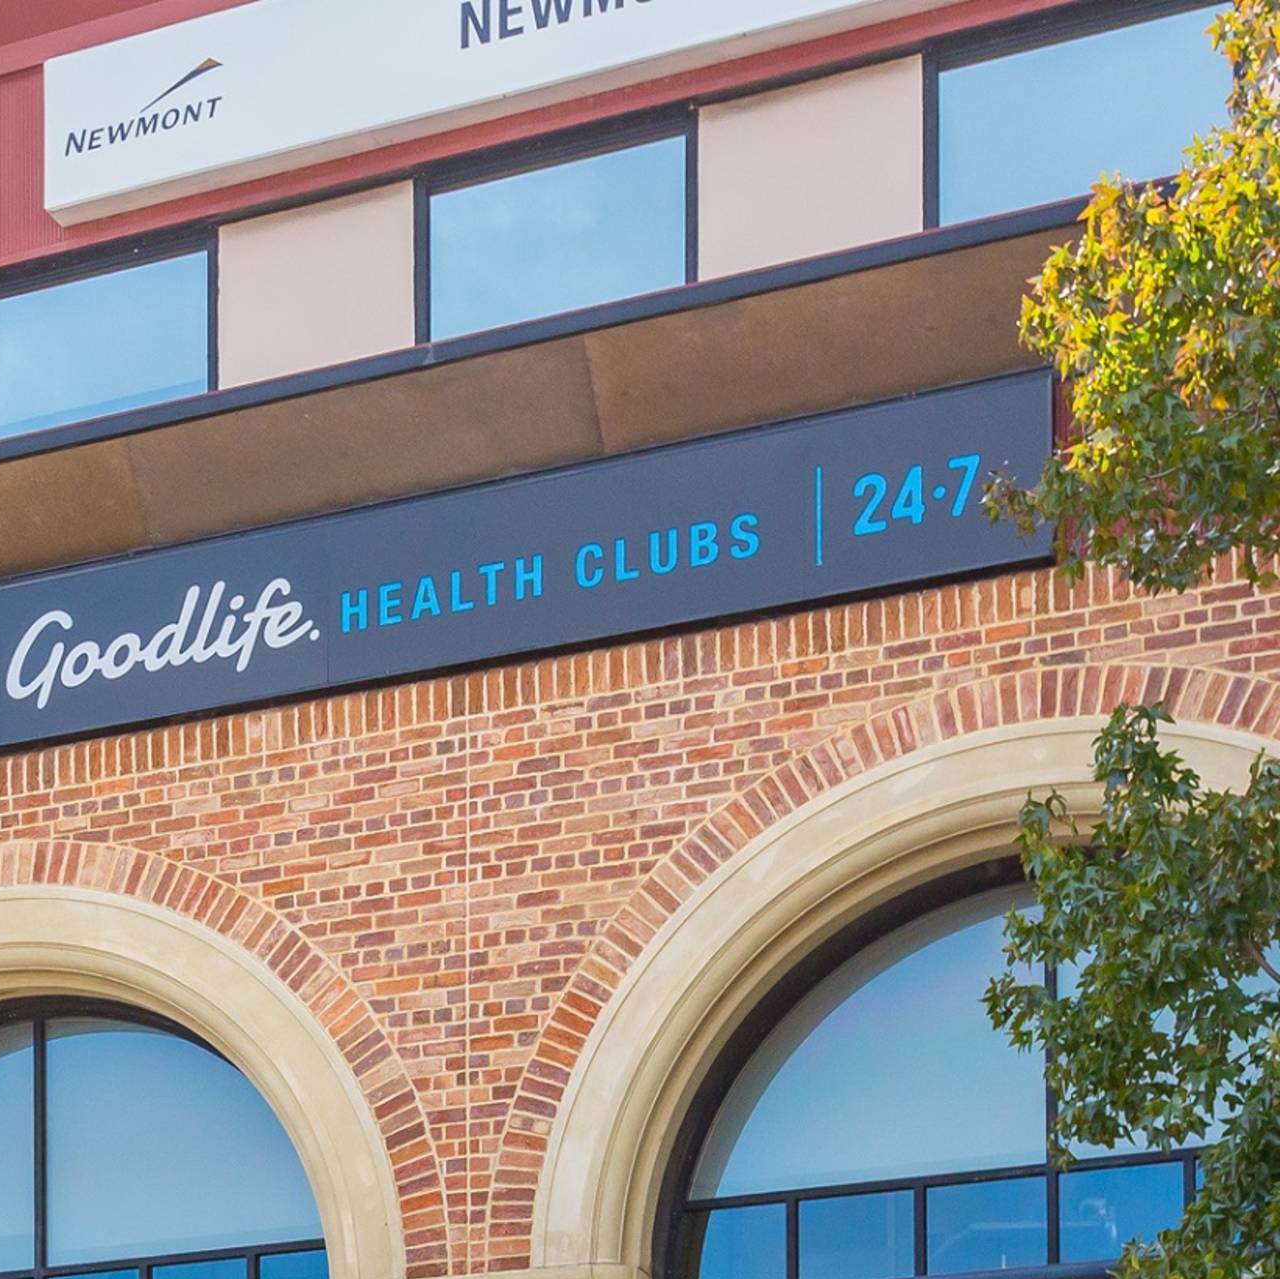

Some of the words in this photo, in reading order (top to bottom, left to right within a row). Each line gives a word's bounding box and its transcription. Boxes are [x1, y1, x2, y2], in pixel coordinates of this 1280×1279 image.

[64, 96, 222, 157] NEWMONT
[341, 555, 543, 633] HEALTH
[575, 512, 760, 589] CLUBS
